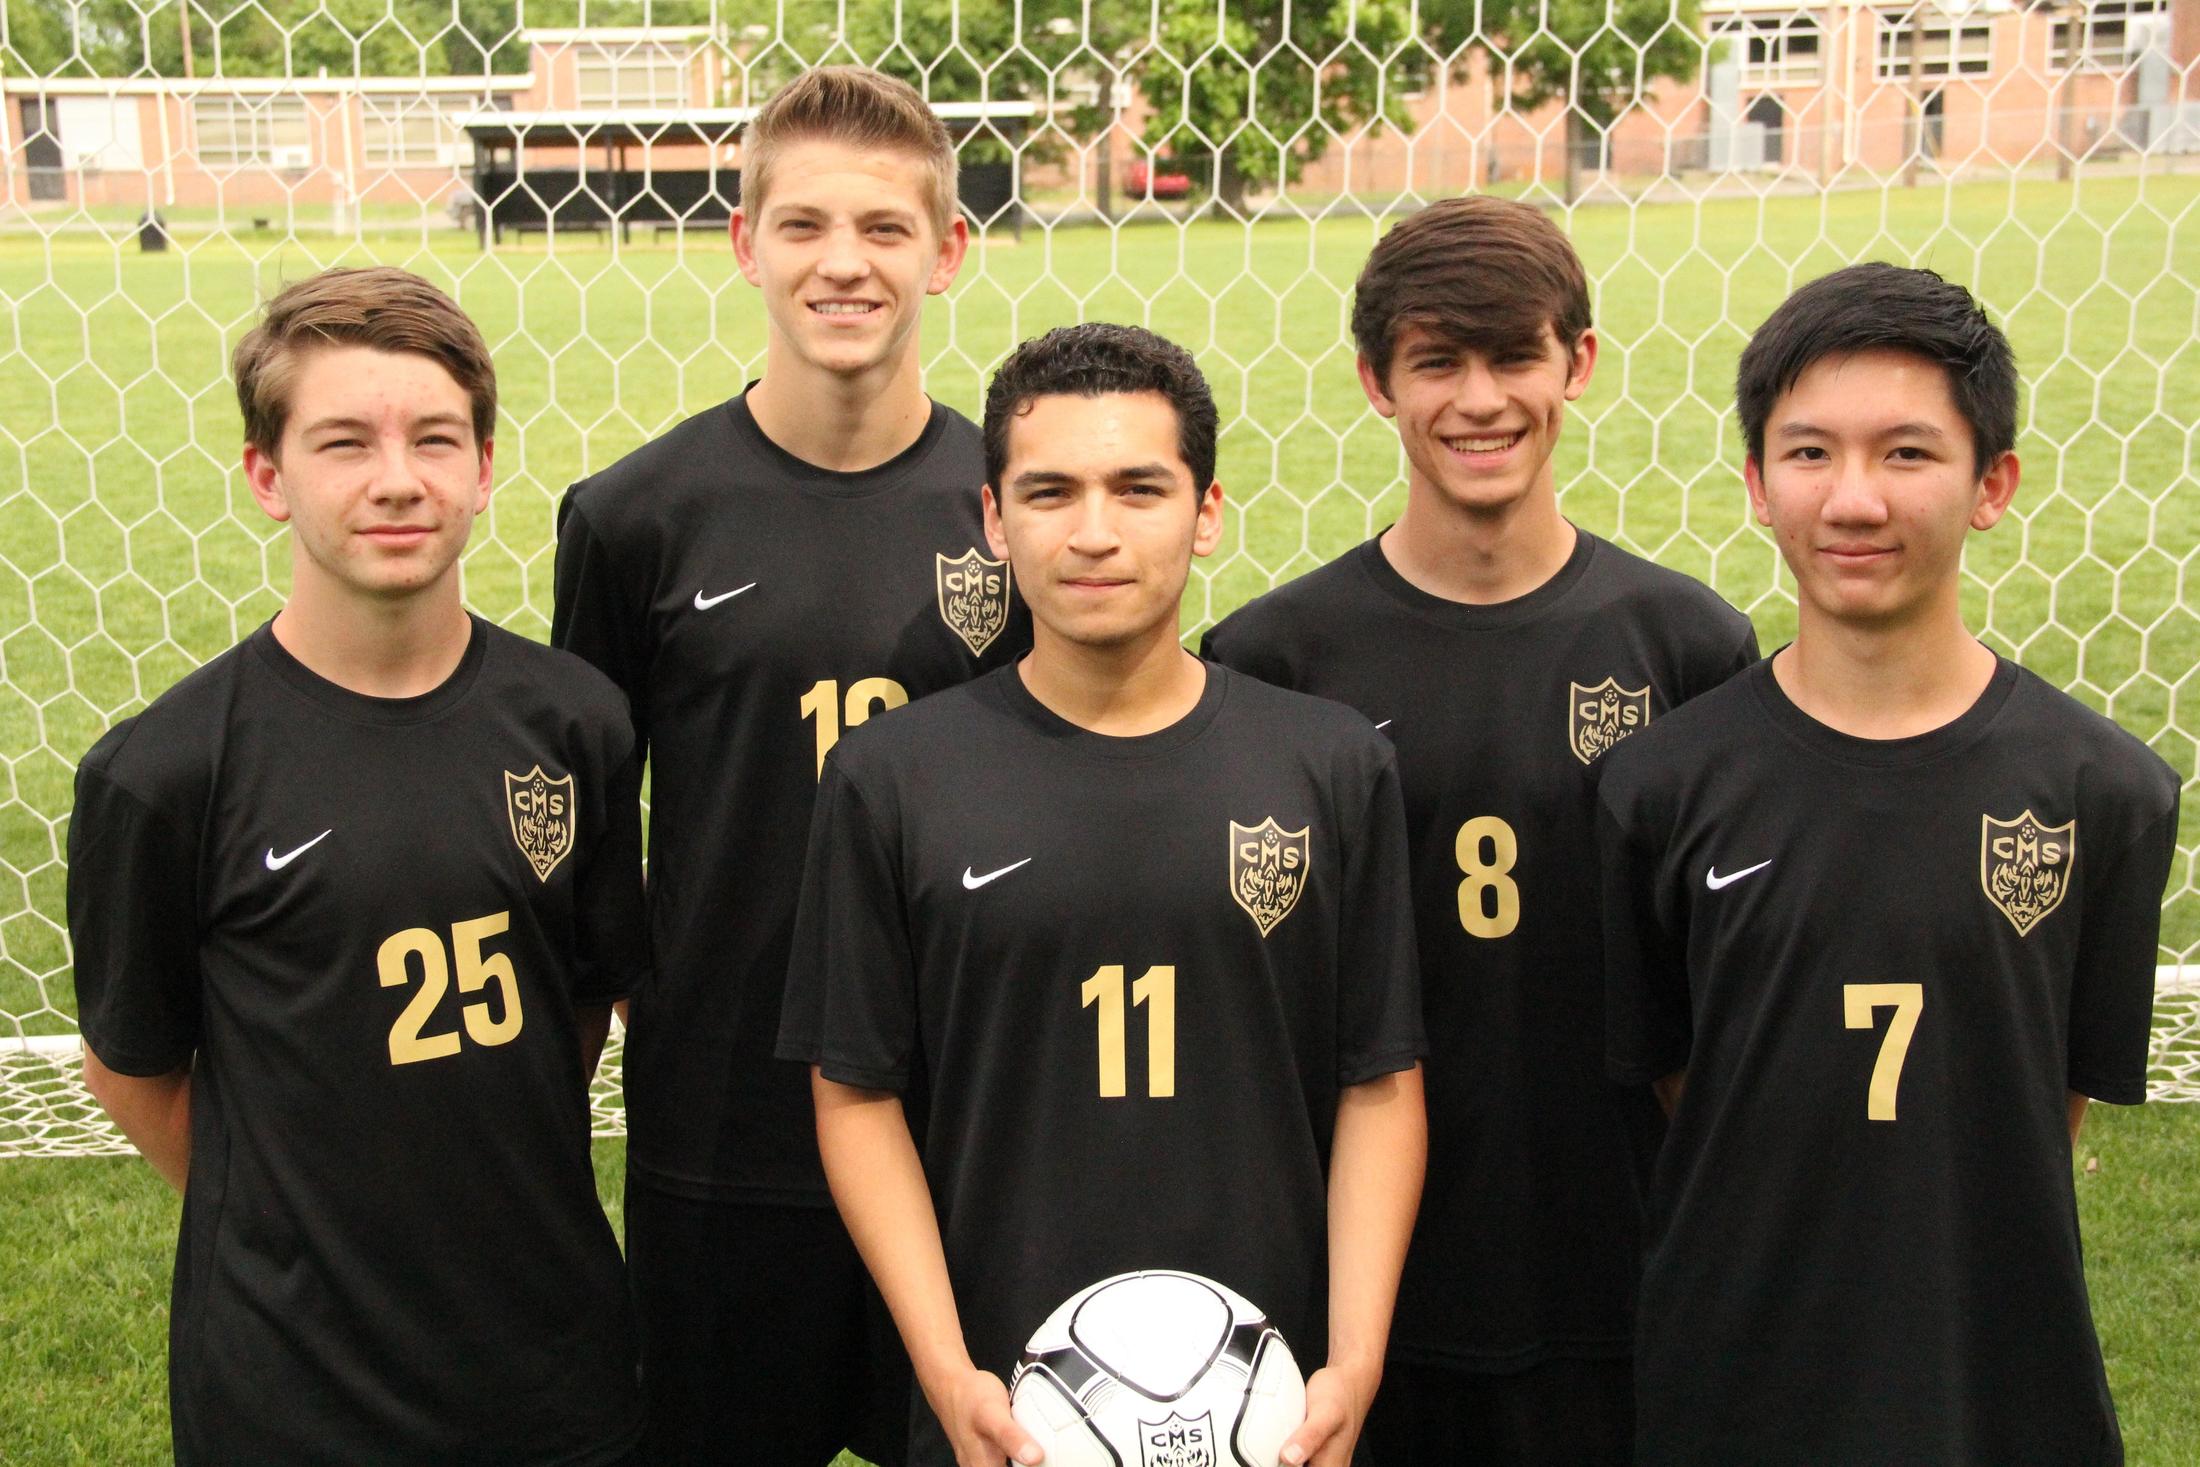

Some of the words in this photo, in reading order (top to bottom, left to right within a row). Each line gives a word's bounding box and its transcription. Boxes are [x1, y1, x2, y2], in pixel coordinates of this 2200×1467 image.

[946, 571, 1001, 596] CMS
[1578, 698, 1639, 727] CMS
[514, 787, 564, 818] CMS
[1239, 841, 1300, 871] CMS
[1992, 833, 2069, 868] CMS
[1456, 816, 1519, 938] 8
[377, 911, 523, 1065] 25
[1082, 965, 1175, 1097] 11
[1844, 983, 1923, 1120] 7
[1150, 1428, 1204, 1447] CMS
